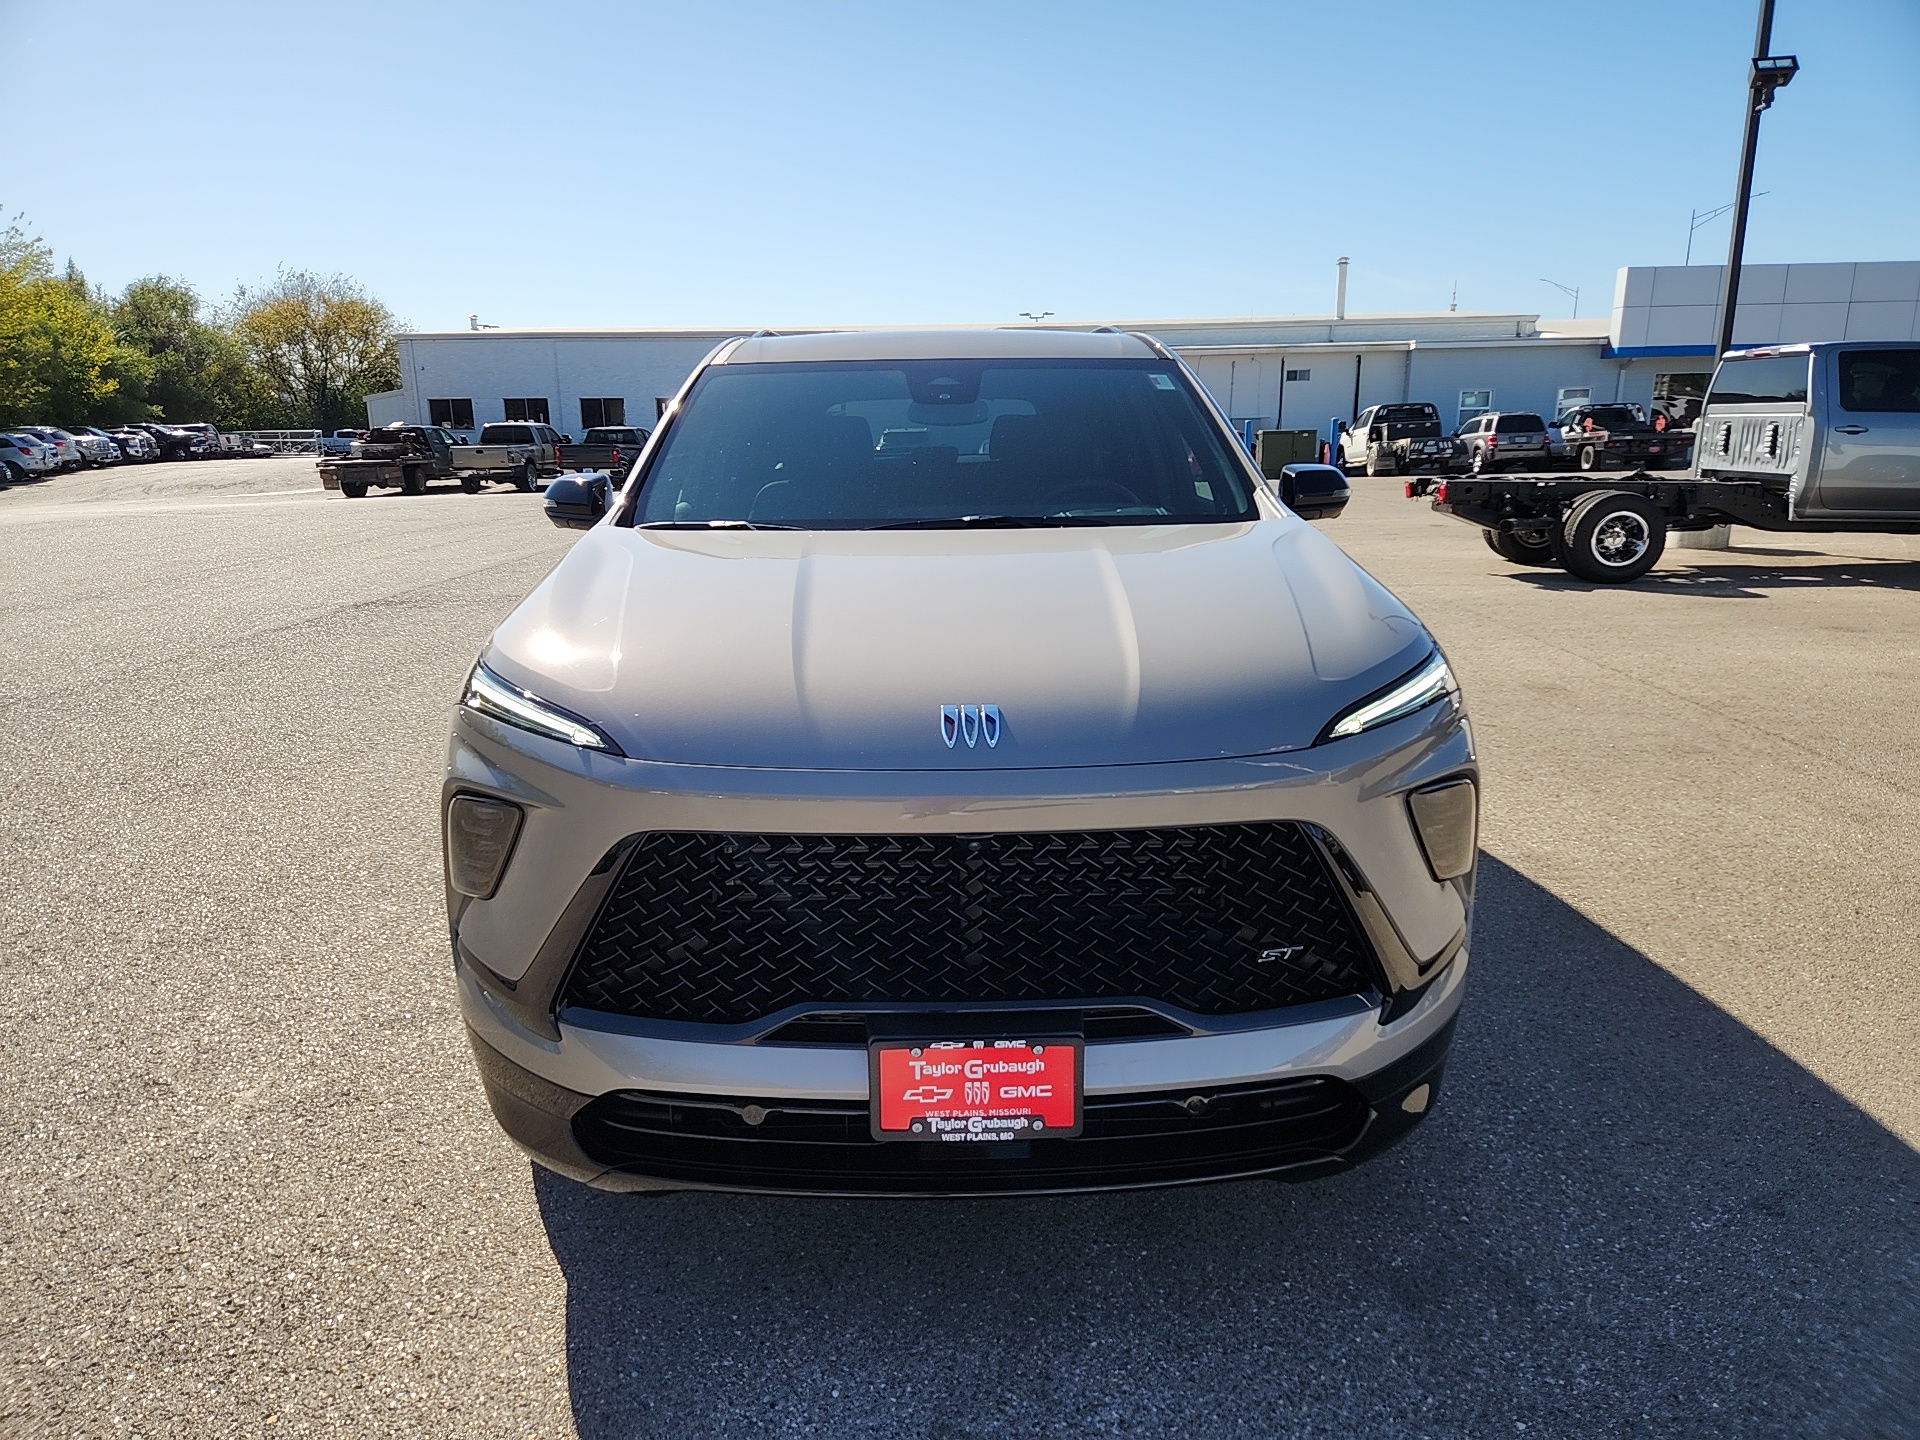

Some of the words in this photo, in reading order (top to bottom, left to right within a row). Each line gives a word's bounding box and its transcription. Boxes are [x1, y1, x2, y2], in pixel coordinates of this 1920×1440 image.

[1257, 946, 1304, 963] ST
[994, 1040, 1026, 1048] GMC
[909, 1061, 962, 1080] Taylor
[964, 1059, 1044, 1079] Grubaugh
[1001, 1085, 1053, 1098] GMC
[925, 1110, 951, 1118] WEST
[990, 1108, 1031, 1116] MISSOURI
[927, 1118, 967, 1132] Taylor
[968, 1117, 1028, 1133] Grubaugh
[942, 1133, 966, 1141] WEST
[967, 1133, 999, 1141] PLAINS,
